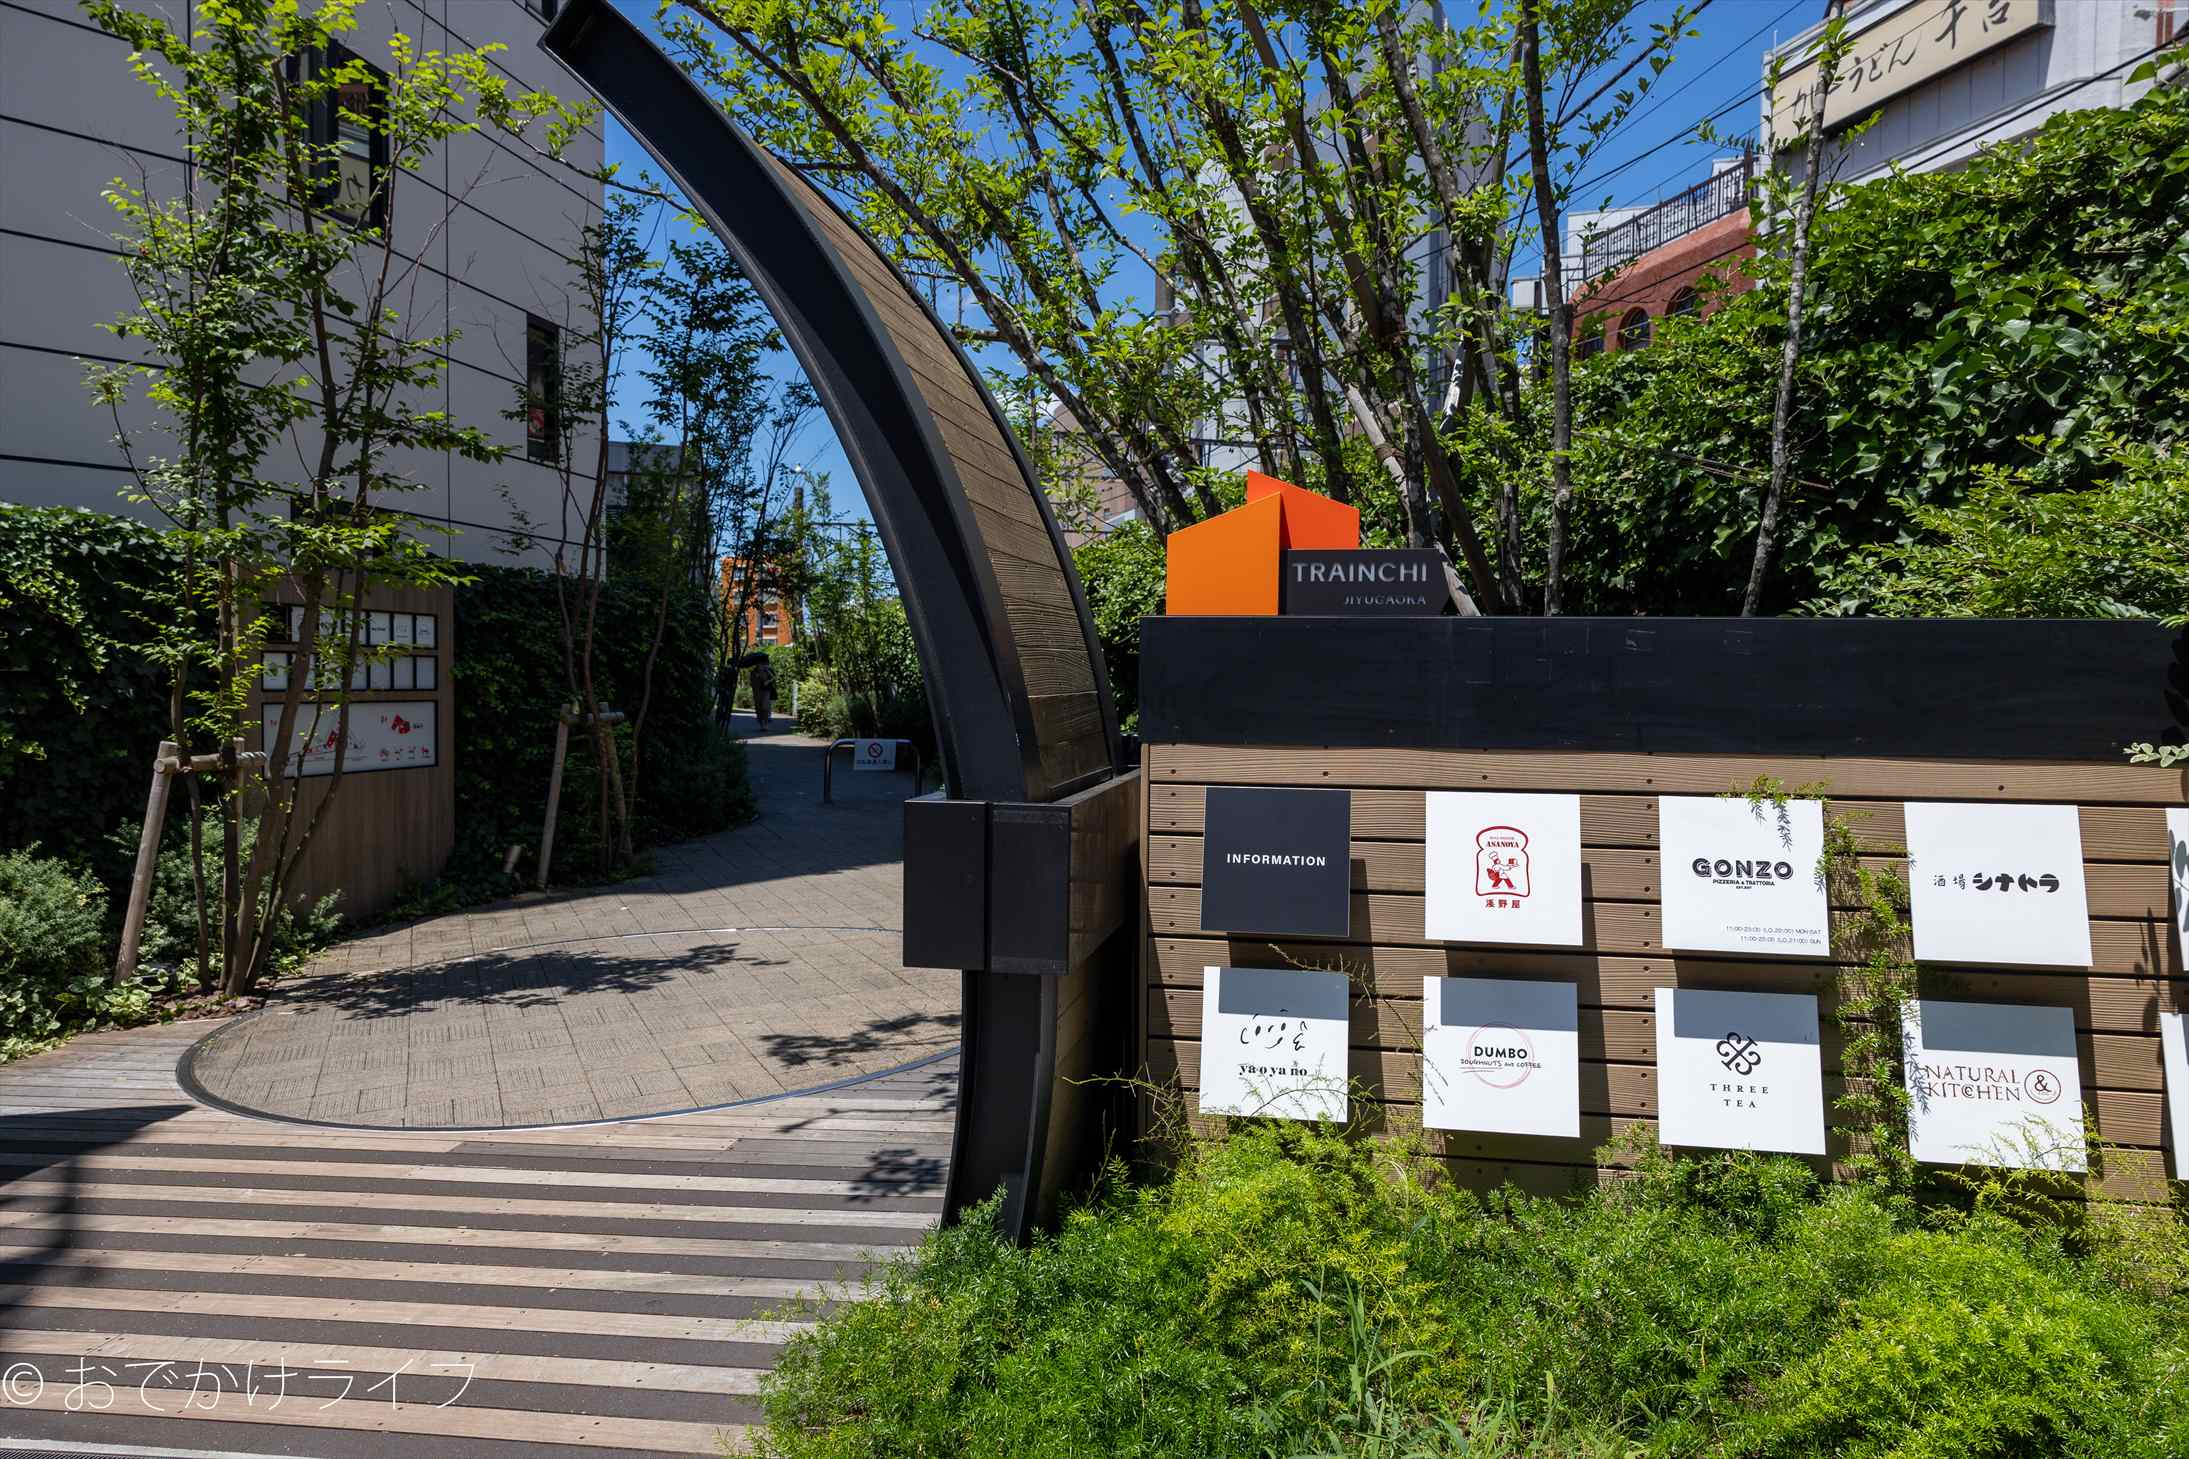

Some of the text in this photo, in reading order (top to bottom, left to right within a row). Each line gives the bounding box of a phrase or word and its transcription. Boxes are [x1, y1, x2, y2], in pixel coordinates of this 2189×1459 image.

[1292, 562, 1427, 582] TRAINCHI
[1487, 840, 1519, 848] ASANOYA
[1226, 853, 1326, 866] INFORMATION
[1692, 857, 1793, 880] GONZO
[1474, 1046, 1528, 1059] DUMBO
[1925, 1065, 2020, 1083] NATURAL
[1710, 1083, 1769, 1094] THREE
[1927, 1081, 2020, 1101] KITCHEN
[1723, 1099, 1756, 1108] TEA
